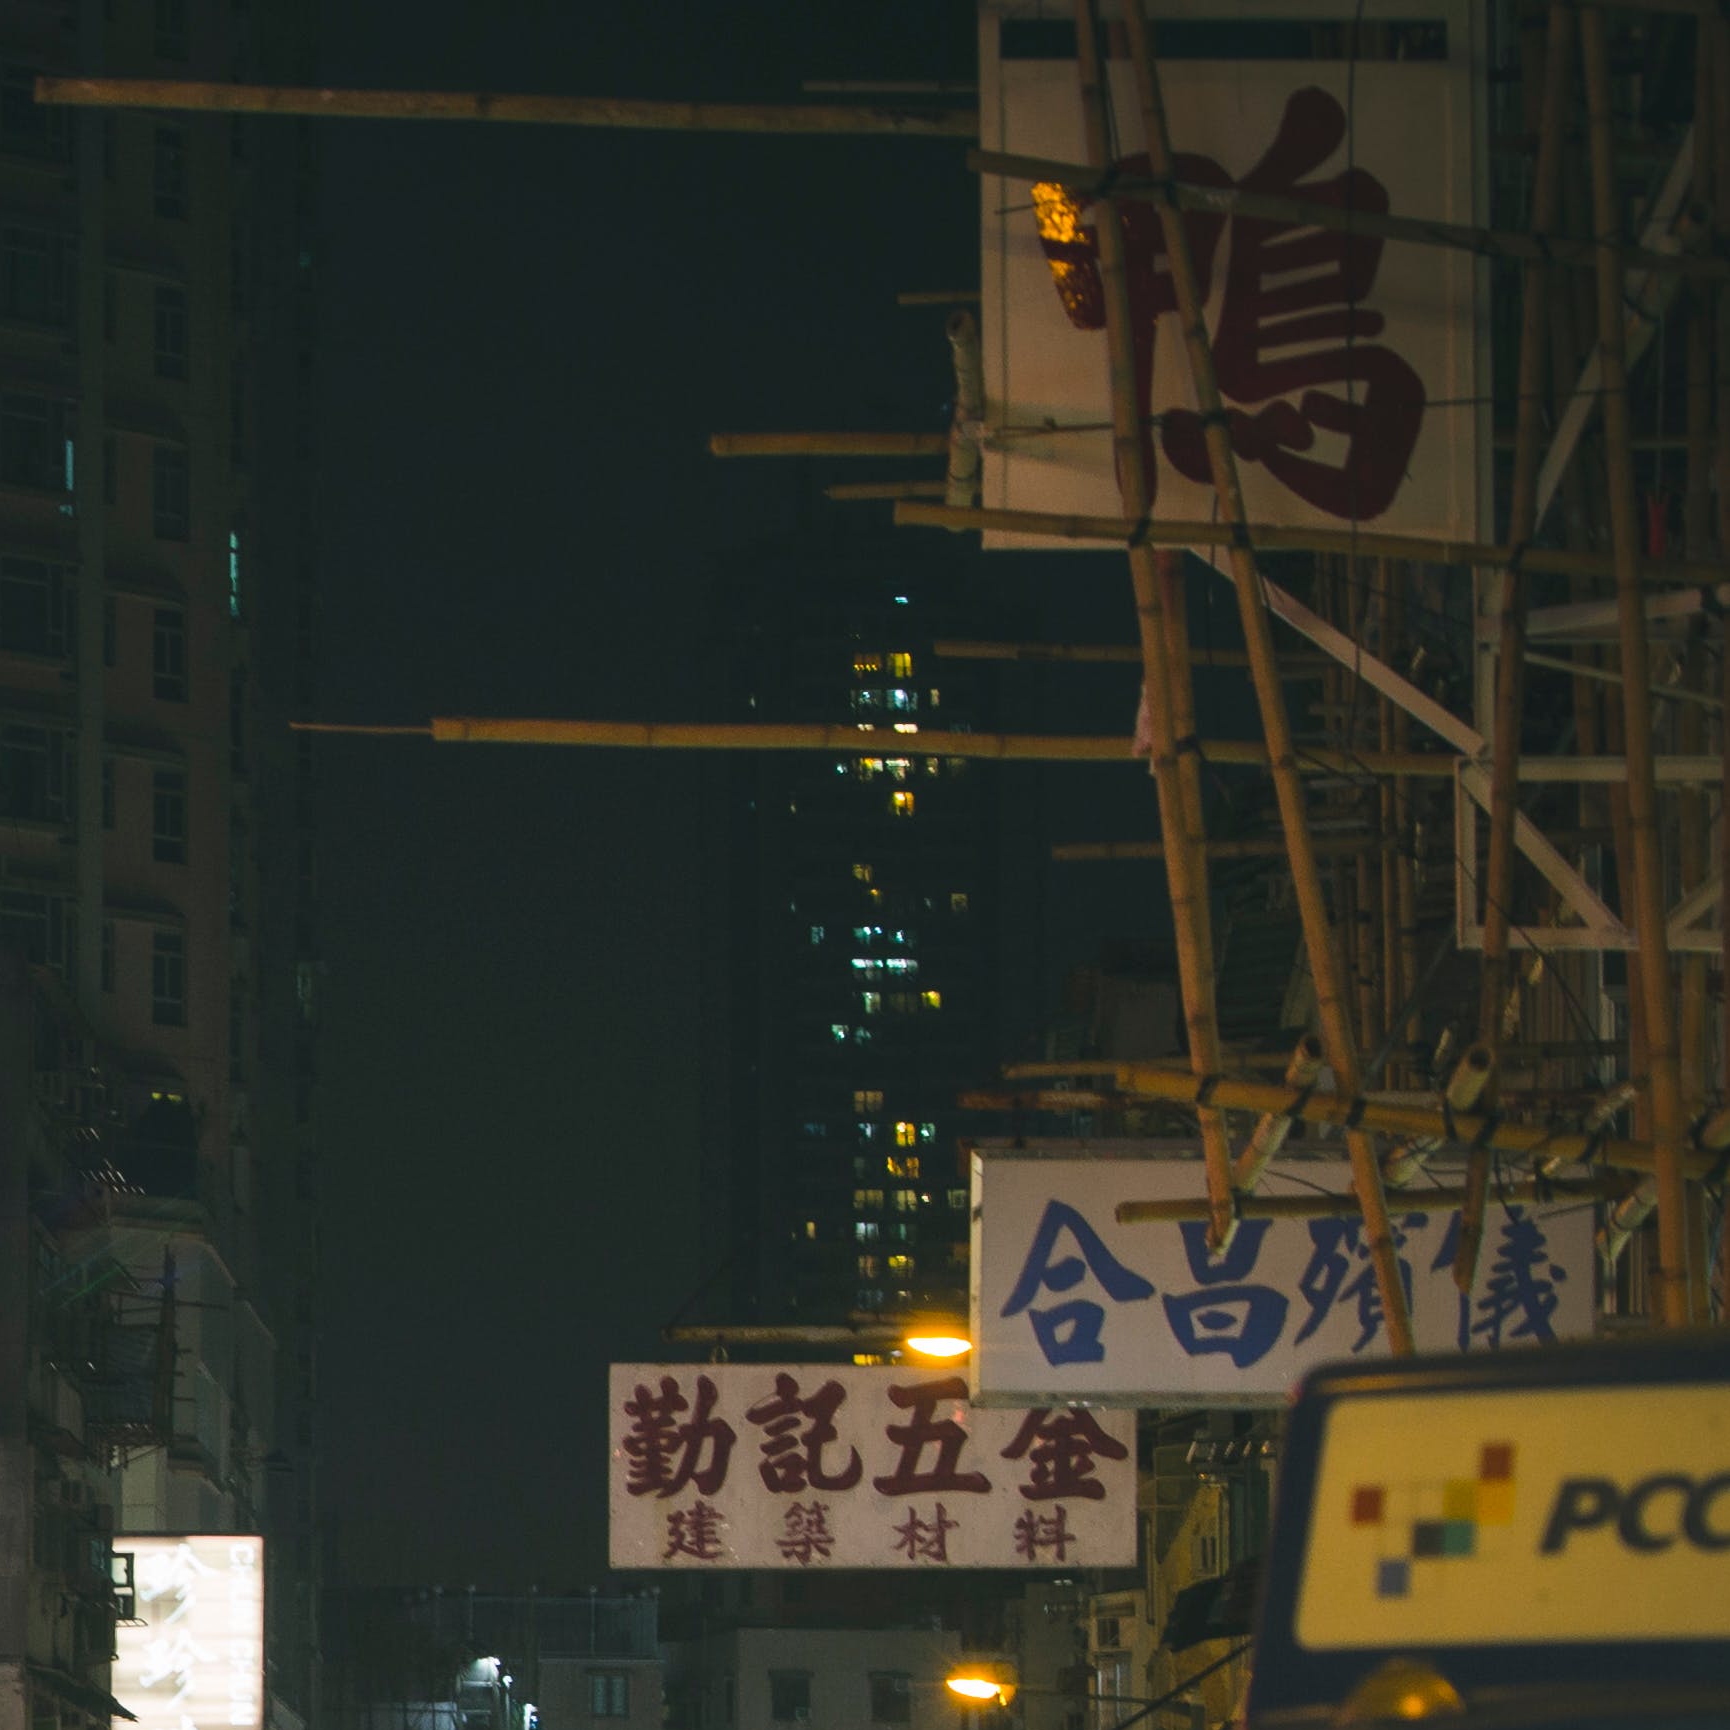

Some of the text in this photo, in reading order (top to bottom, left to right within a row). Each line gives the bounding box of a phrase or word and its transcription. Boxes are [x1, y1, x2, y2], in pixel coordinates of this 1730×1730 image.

[622, 1371, 1128, 1501] 勤記五金
[664, 1502, 1076, 1565] 建築材料
